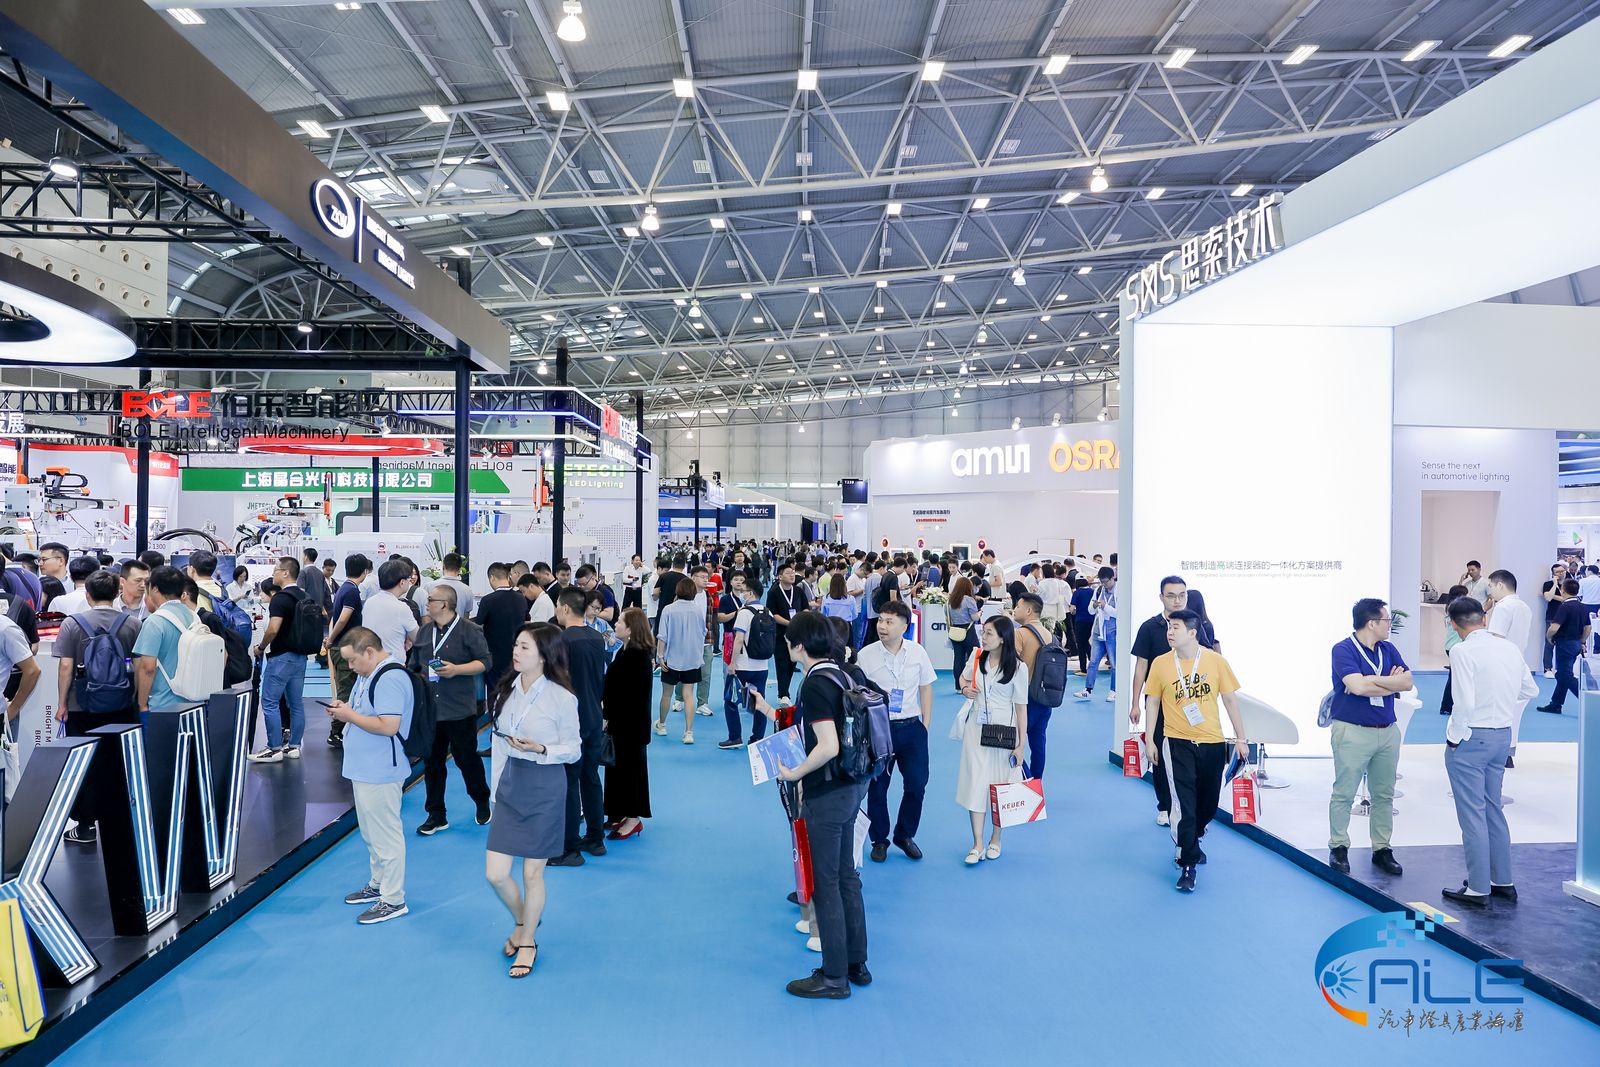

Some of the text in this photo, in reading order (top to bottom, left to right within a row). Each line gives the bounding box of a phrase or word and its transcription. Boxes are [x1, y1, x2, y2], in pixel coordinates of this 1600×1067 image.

[1181, 192, 1285, 293] 思索技术
[121, 423, 349, 441] BOLE Intelligent Machinery
[1049, 440, 1120, 473] OSR
[1421, 461, 1446, 470] Sense
[1447, 462, 1461, 470] the
[1421, 472, 1510, 482] in automotive lighting
[588, 480, 624, 489] Lighting
[741, 505, 769, 514] tederic
[1180, 560, 1343, 571] 智能制造高端连接器的一体化方案提供商
